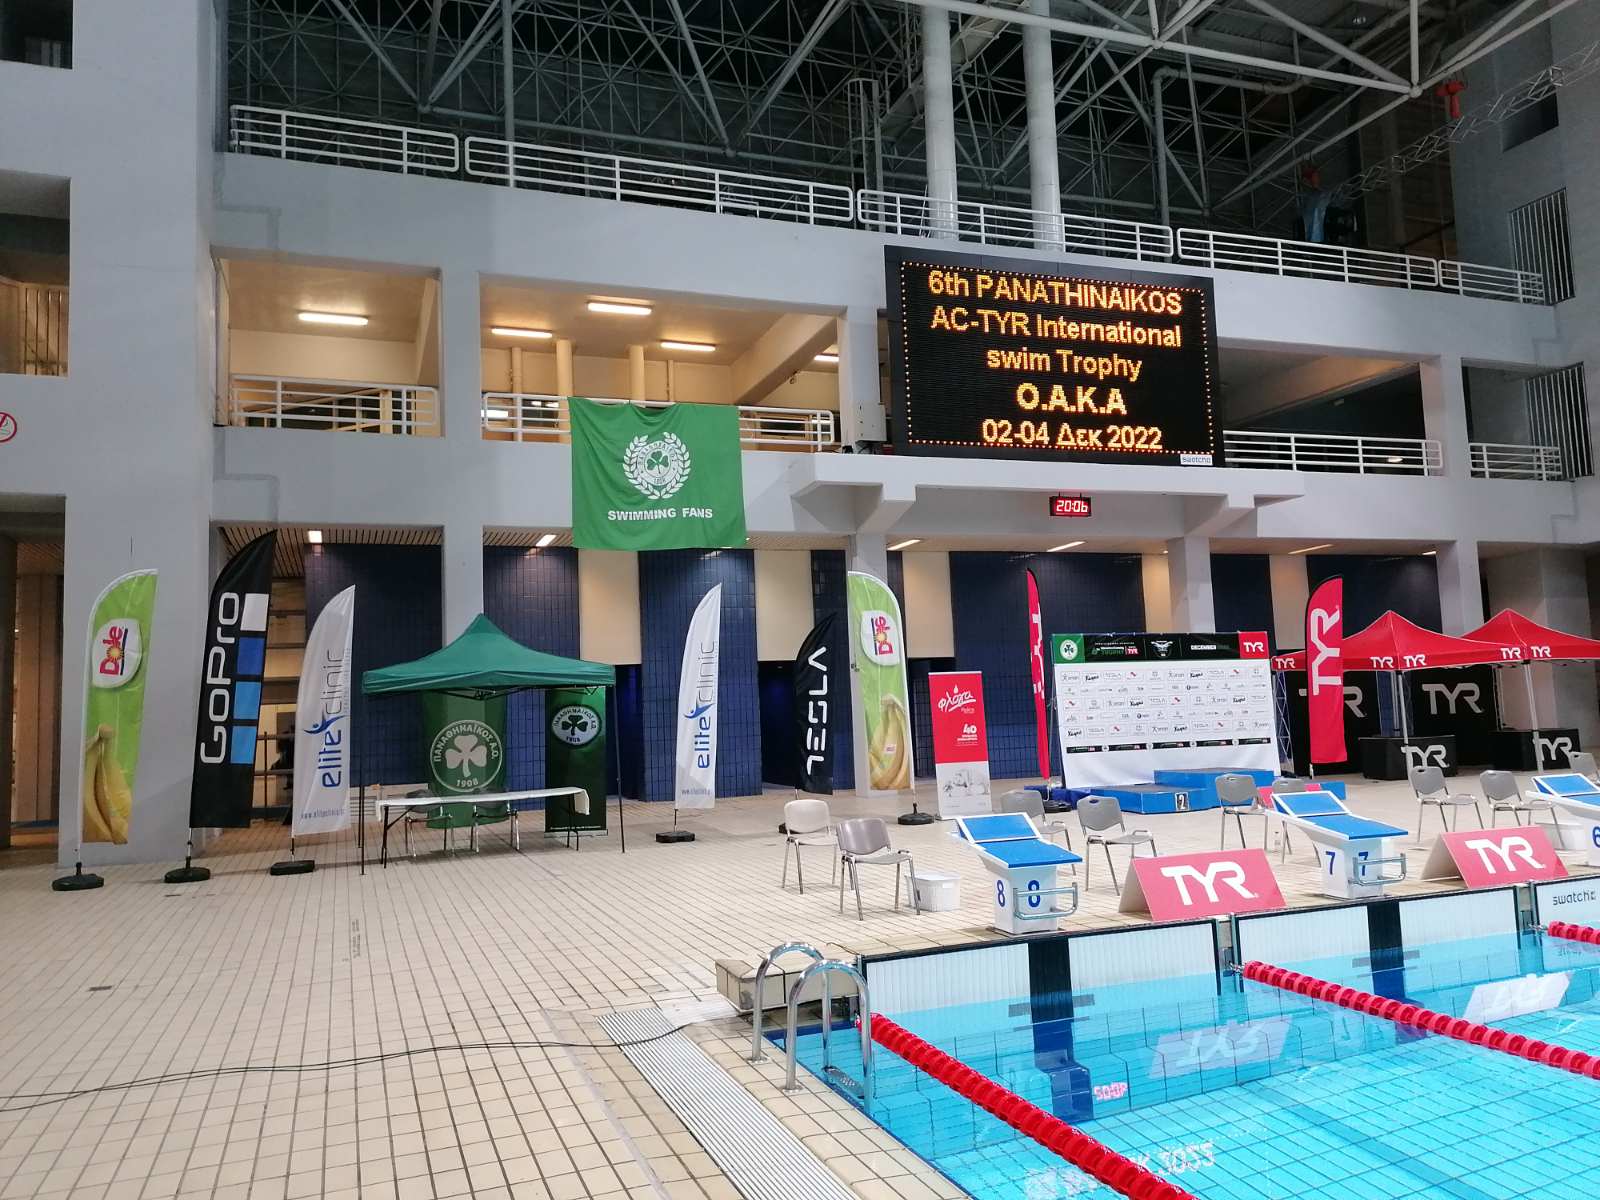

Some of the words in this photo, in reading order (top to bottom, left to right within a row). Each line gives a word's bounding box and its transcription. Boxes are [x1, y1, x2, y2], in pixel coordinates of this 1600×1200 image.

[928, 270, 969, 297] 6th
[977, 275, 1182, 315] PANATHINAIKOS
[931, 305, 1030, 336] AC-TYR
[1037, 313, 1182, 348] International
[987, 347, 1050, 372] swim
[1056, 349, 1143, 382] Trophy
[1016, 382, 1128, 415] O.A.K.A
[982, 419, 1050, 445] 02-04
[1056, 422, 1103, 448] Δεκ
[1107, 425, 1163, 450] 2022
[607, 508, 677, 521] SWIMMING
[682, 507, 713, 519] FANS
[1056, 500, 1089, 513] 20:06
[99, 625, 123, 676] Dole
[1243, 641, 1265, 653] TYR
[1311, 605, 1341, 696] TYR
[1403, 654, 1427, 667] TYR
[1500, 647, 1521, 660] TYR
[1531, 645, 1552, 658] TYR
[1276, 657, 1296, 669] TYR
[1370, 656, 1394, 669] TYR
[1422, 682, 1484, 715] TYR
[694, 715, 712, 769] elite
[318, 729, 342, 788] elite
[456, 778, 479, 788] 1908
[1325, 851, 1336, 875] 7
[1358, 851, 1369, 877] 7
[1465, 836, 1544, 874] TYR
[996, 880, 1006, 907] 8
[1028, 880, 1041, 908] 8
[1160, 861, 1257, 906] TYR
